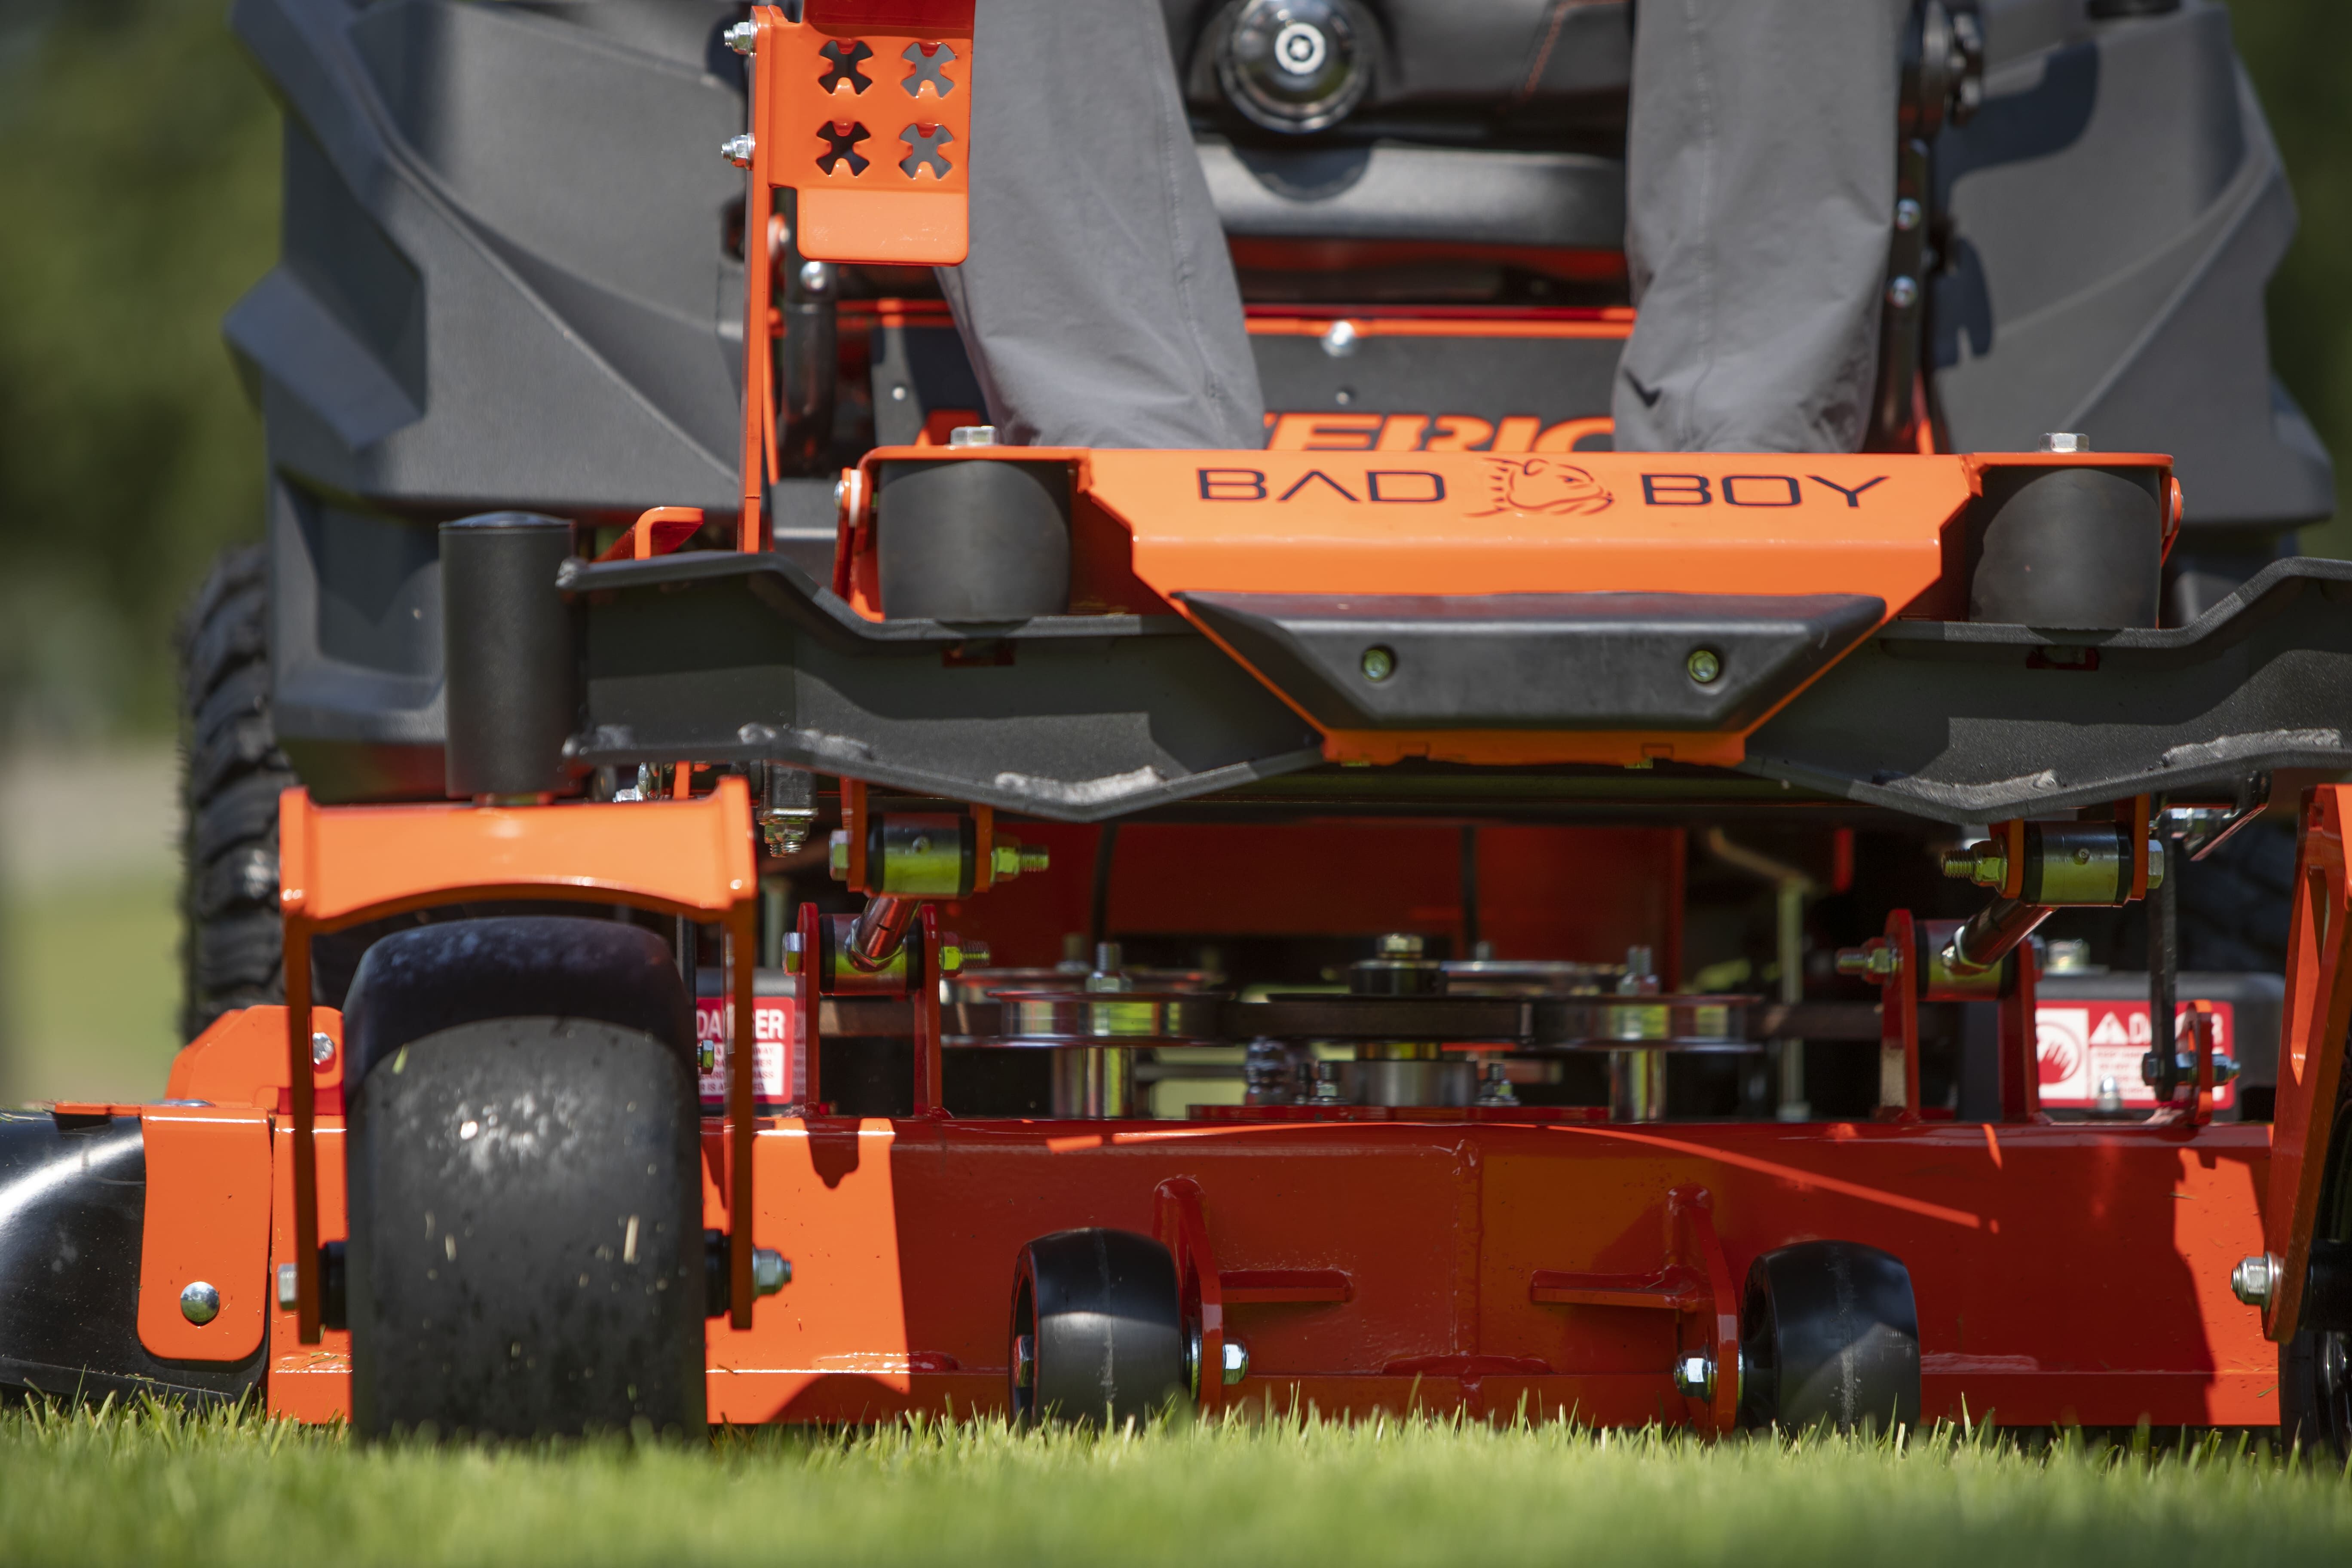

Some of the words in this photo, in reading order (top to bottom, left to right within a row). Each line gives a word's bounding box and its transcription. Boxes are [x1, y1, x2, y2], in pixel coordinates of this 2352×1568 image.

[1196, 467, 1446, 503] BAD
[1640, 473, 1890, 508] BOY
[697, 1008, 786, 1040] DAER
